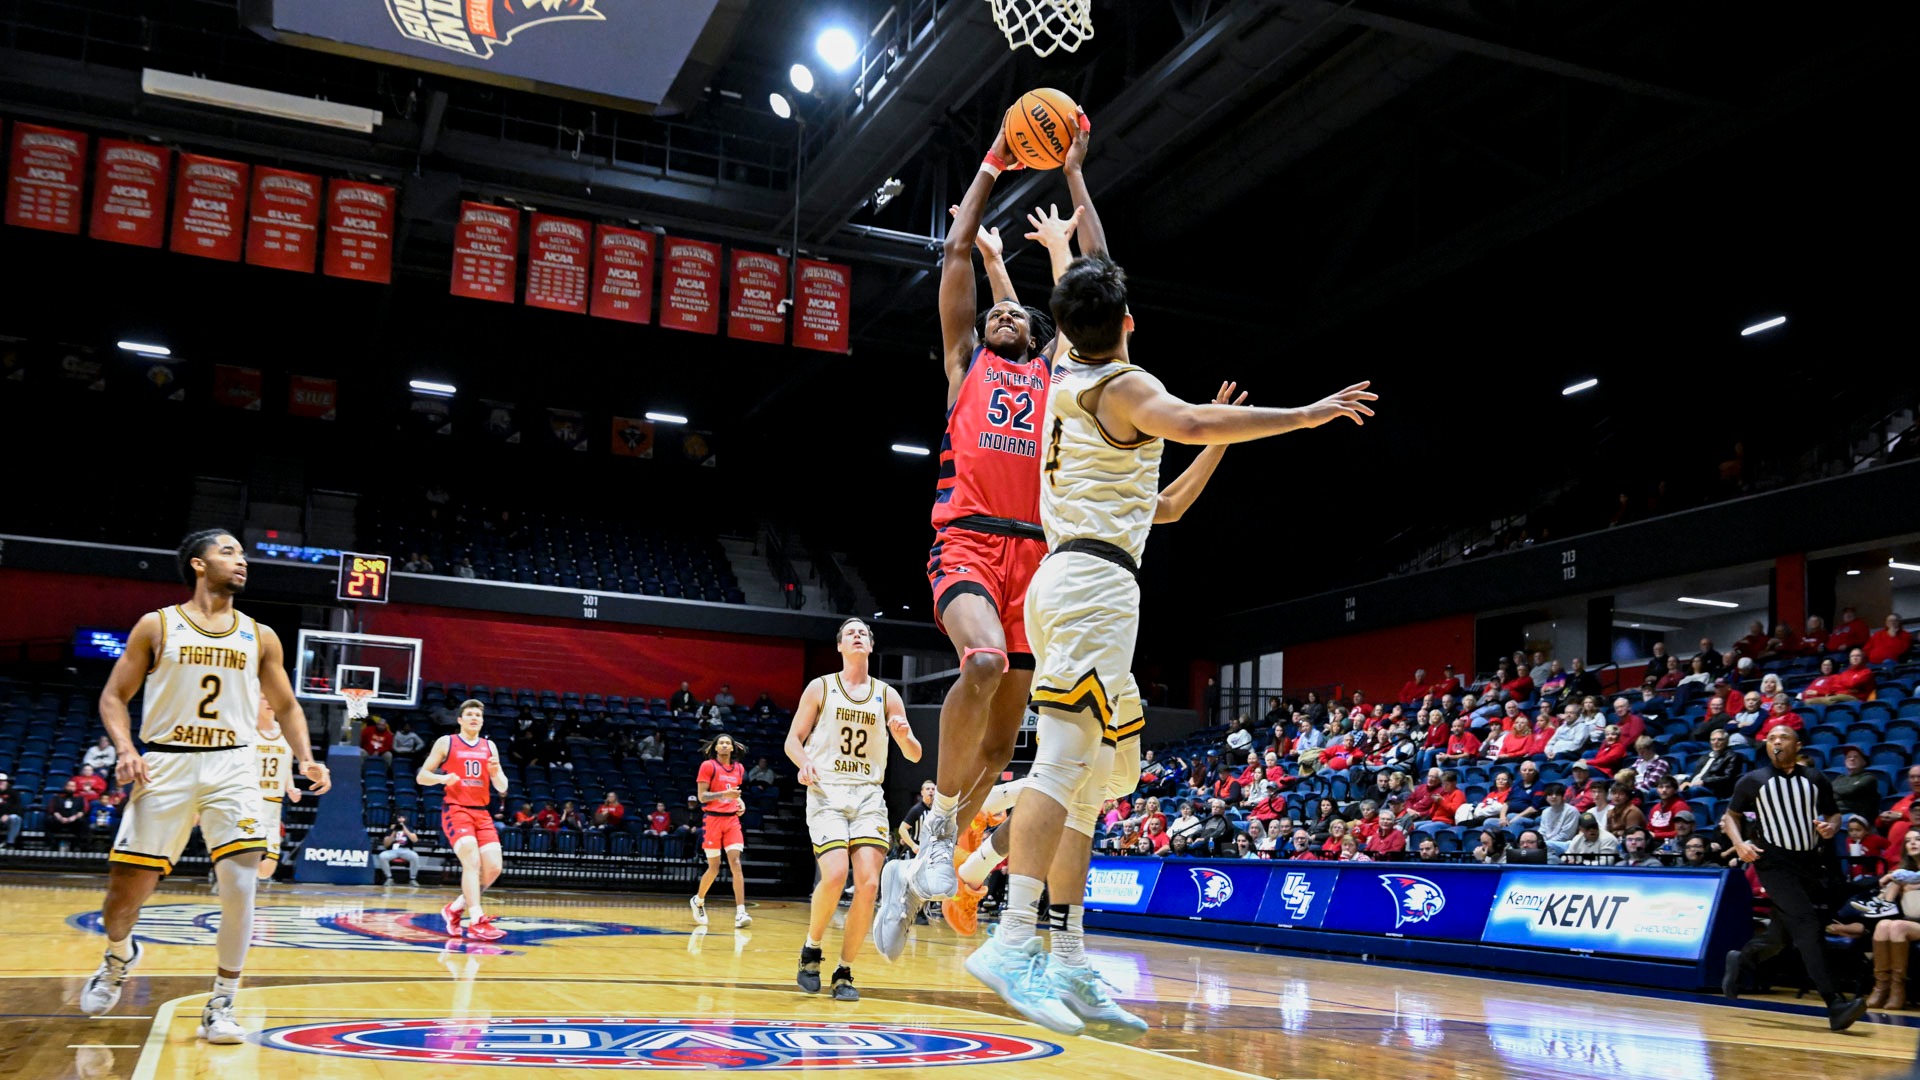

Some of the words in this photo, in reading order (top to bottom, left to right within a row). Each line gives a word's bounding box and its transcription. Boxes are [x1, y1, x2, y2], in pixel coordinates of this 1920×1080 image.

[1031, 103, 1064, 155] Wilson
[343, 217, 377, 230] NCAA
[470, 241, 501, 252] GLVC
[543, 251, 574, 264] NCAA
[607, 267, 638, 280] NCAA
[676, 277, 705, 290] NCAA
[743, 288, 772, 301] NCAA
[808, 298, 836, 311] NCAA
[986, 387, 1035, 433] 52
[978, 431, 1036, 457] INDIANA
[1562, 550, 1576, 564] 213
[1563, 566, 1576, 580] 113
[348, 571, 380, 597] 27
[583, 595, 599, 606] 201
[583, 608, 598, 618] 101
[179, 645, 247, 671] FIGHTING
[198, 674, 222, 720] 2
[836, 707, 876, 726] FIGHTING
[173, 725, 236, 747] SAINTS
[840, 726, 868, 758] 32
[261, 757, 279, 777] 13
[464, 760, 481, 777] 10
[834, 759, 871, 775] SAINTS
[304, 847, 369, 862] ROMAIN
[1506, 891, 1547, 908] Kenny
[1539, 893, 1629, 930] KENT
[1633, 924, 1699, 937] CHEVROLET
